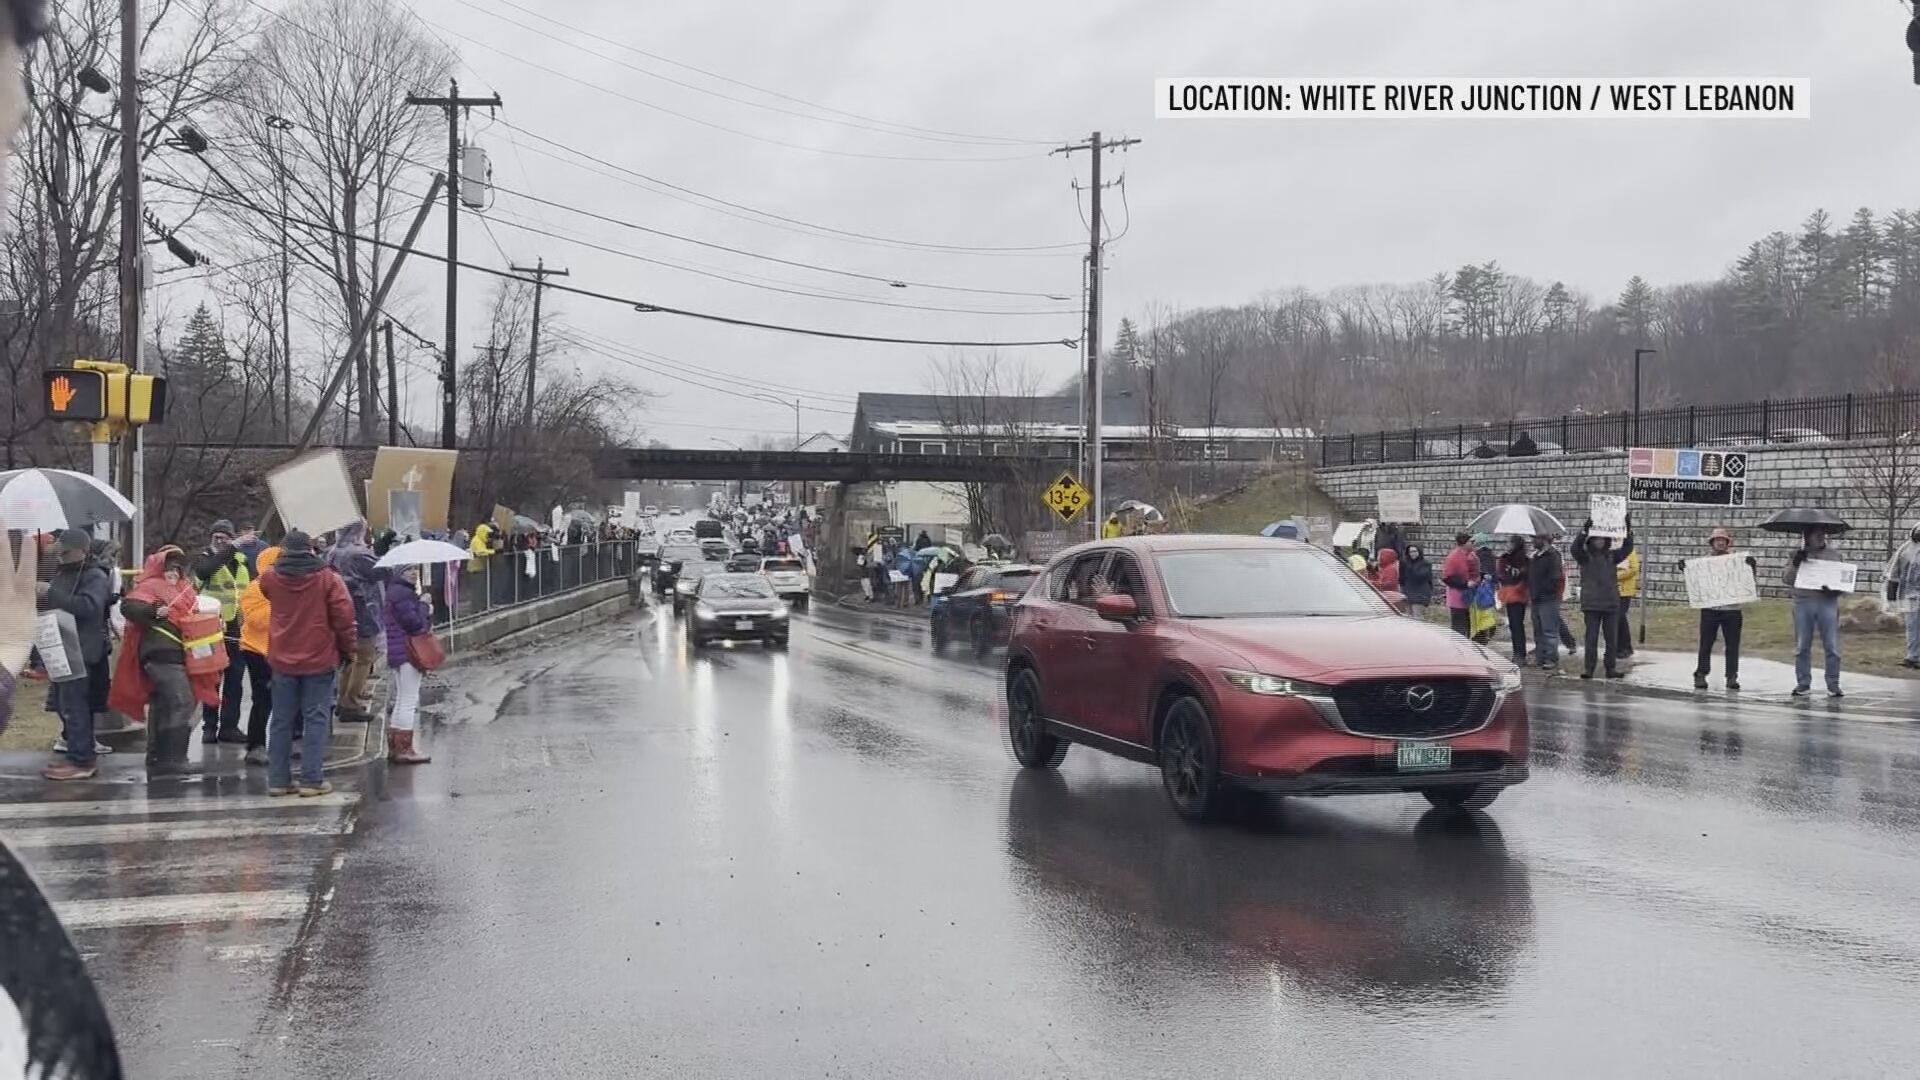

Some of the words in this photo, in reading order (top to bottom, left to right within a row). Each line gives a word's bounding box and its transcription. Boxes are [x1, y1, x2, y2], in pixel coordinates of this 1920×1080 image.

[1634, 479, 1663, 488] Travel
[1666, 480, 1721, 490] Information
[1631, 489, 1647, 499] left
[1650, 491, 1660, 499] at
[1663, 490, 1684, 502] light
